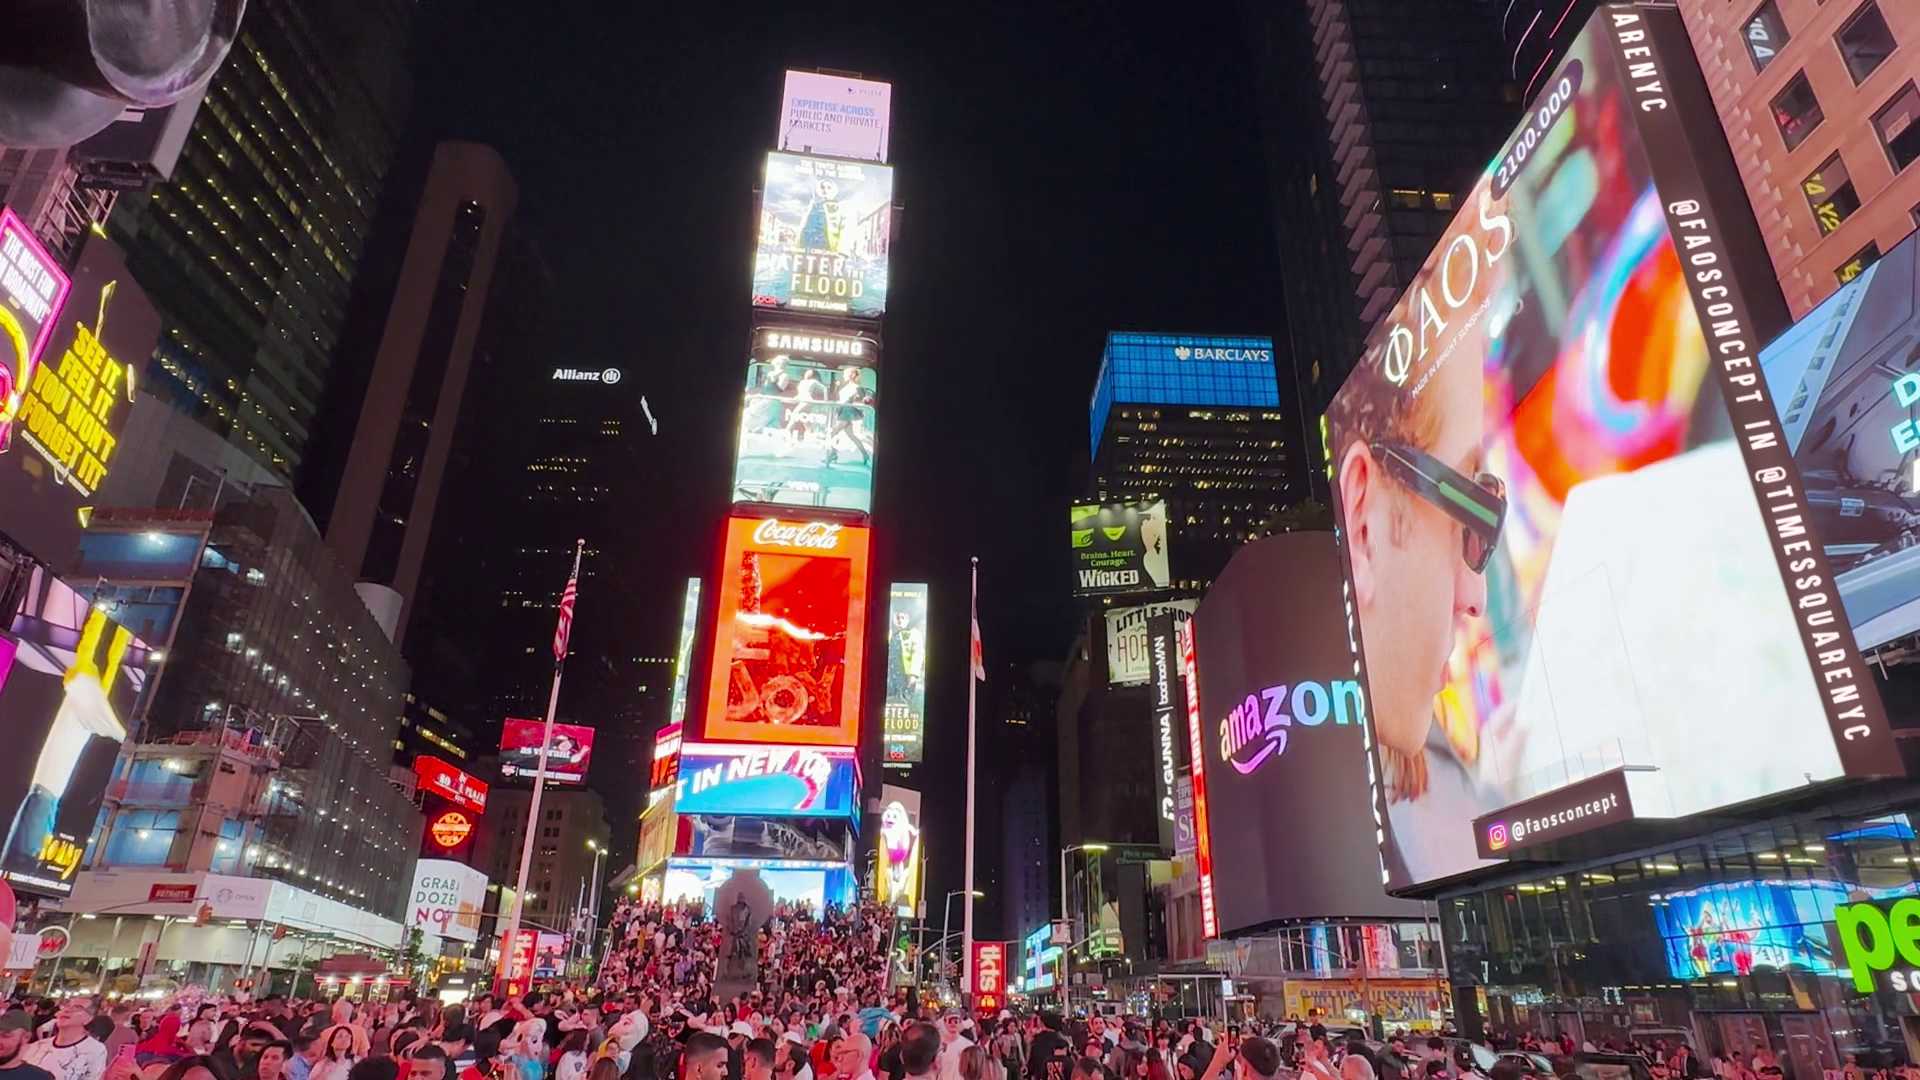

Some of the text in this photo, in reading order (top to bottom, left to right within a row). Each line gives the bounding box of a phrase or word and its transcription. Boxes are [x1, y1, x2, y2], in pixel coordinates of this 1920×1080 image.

[790, 108, 880, 128] PUBLIC AND PRIVATE
[791, 97, 876, 117] EXPERTISE ACROSS
[789, 119, 832, 133] MARKETS
[791, 273, 864, 297] FLOOD
[74, 327, 107, 375] SEE
[767, 333, 863, 356] SAMSUNG
[1194, 348, 1270, 361] BARCLAYS
[31, 360, 72, 415] YOU
[57, 349, 97, 406] FEEL
[552, 368, 600, 381] Allianz
[18, 391, 84, 469] FORGET
[1668, 200, 1871, 741] @FAOSCONCEPT IN @TIMESSQUARENYC
[1116, 606, 1158, 633] LITTLE
[885, 719, 919, 729] FLOOD
[1219, 680, 1365, 761] amazon
[693, 763, 723, 794] IN
[727, 750, 782, 781] NEW
[1511, 792, 1618, 842] @faosconcept
[979, 944, 1001, 993] tkts
